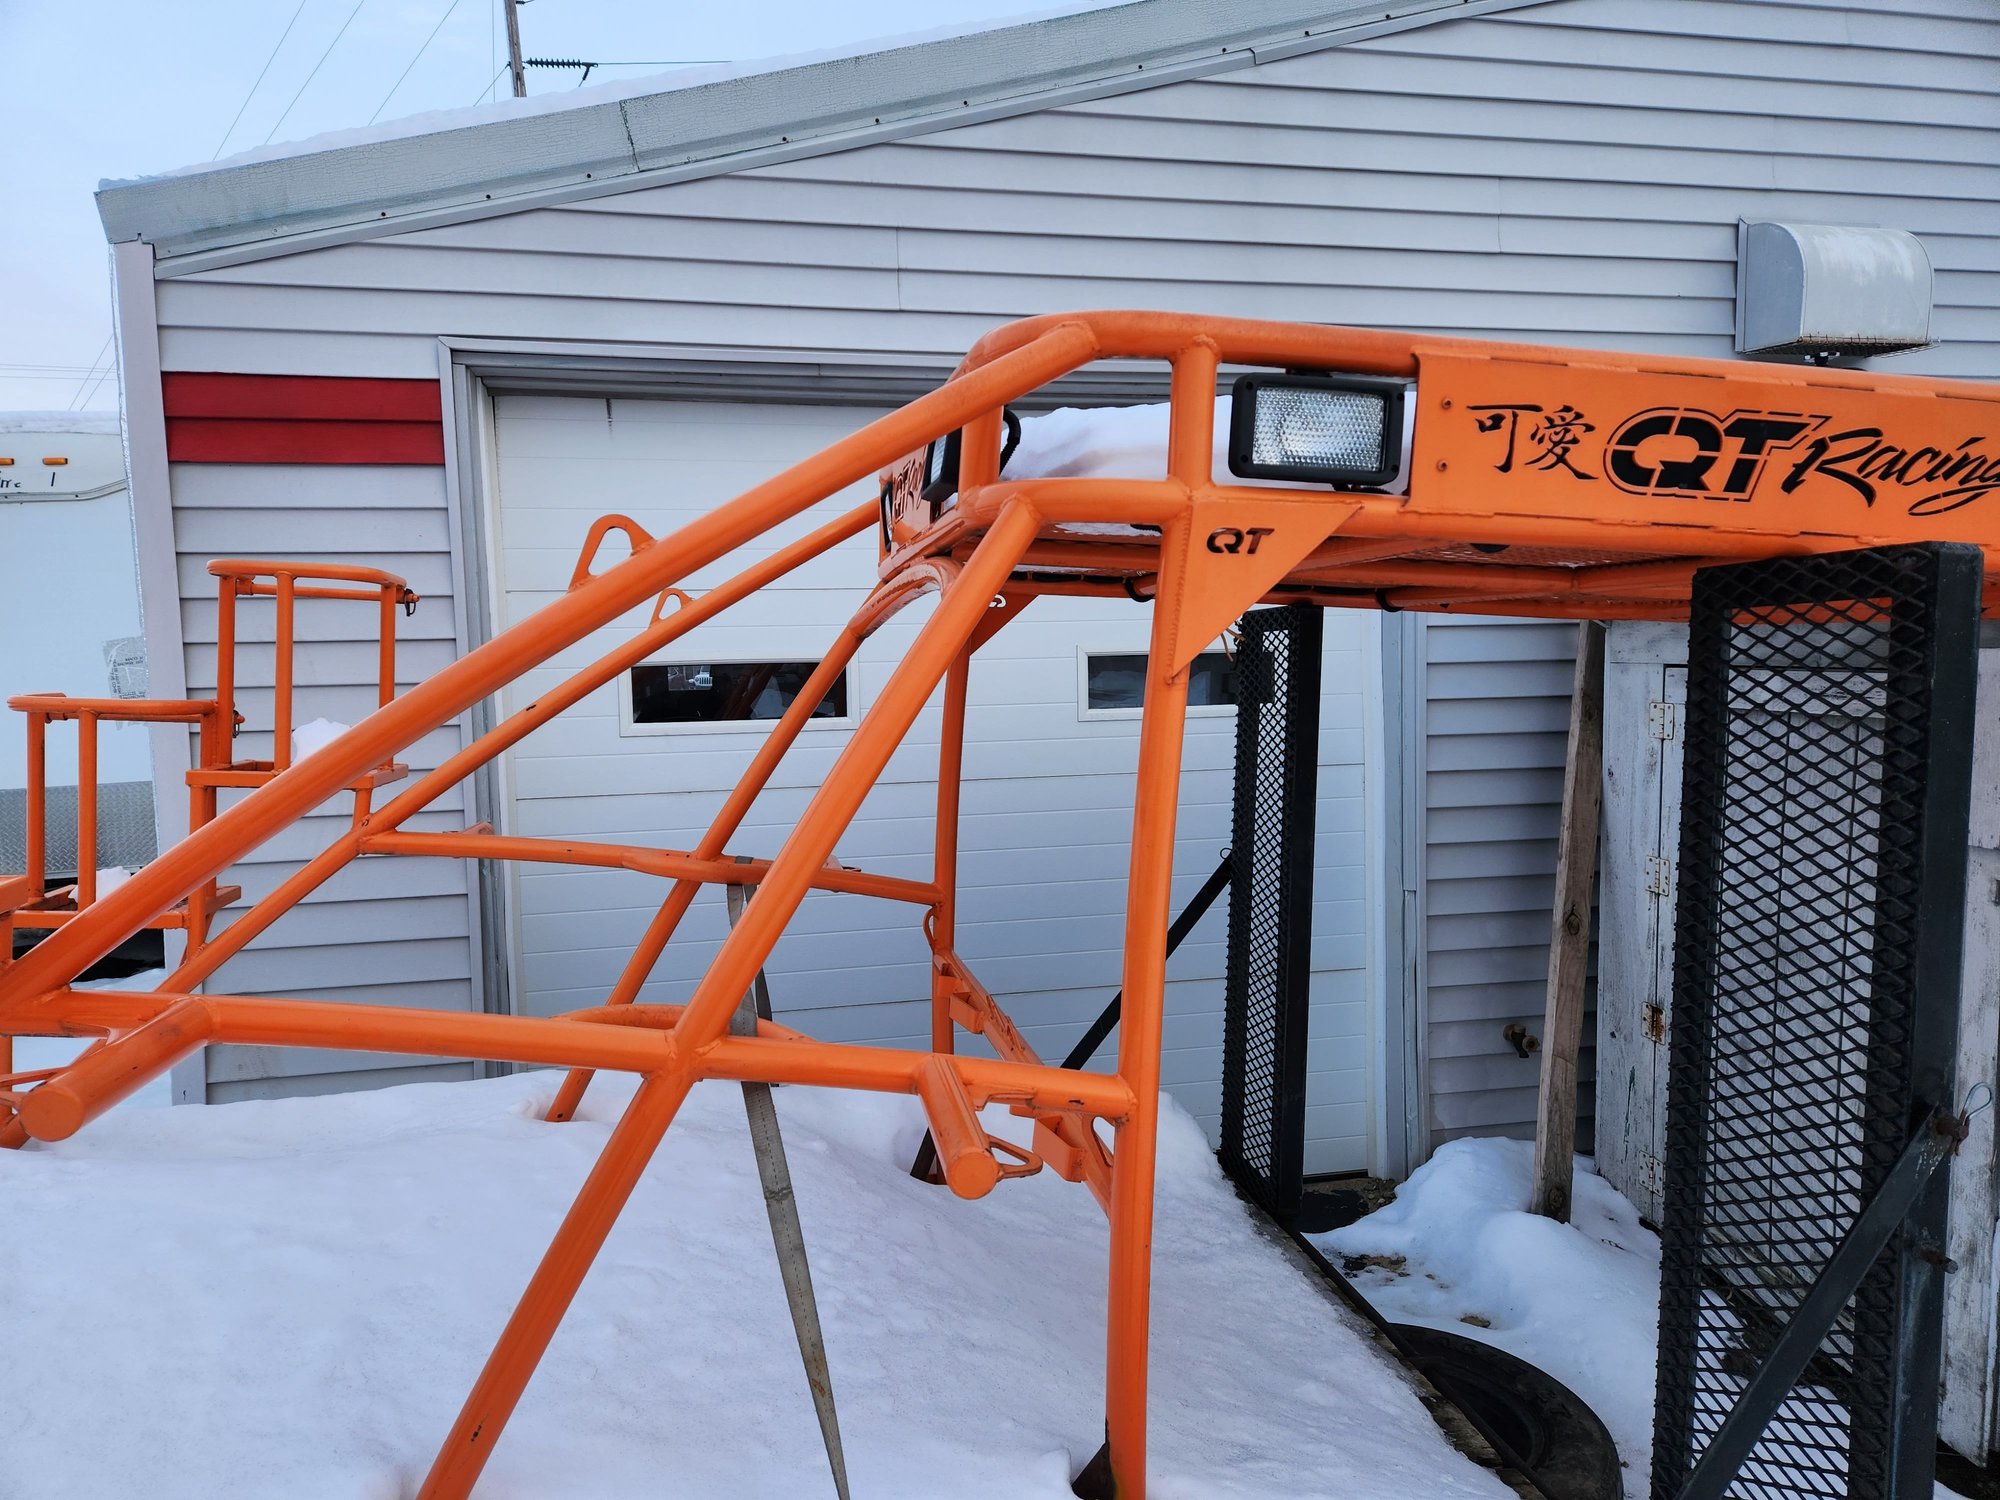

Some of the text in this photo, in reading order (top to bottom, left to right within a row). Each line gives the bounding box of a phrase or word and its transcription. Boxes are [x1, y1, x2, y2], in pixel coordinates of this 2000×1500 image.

[1466, 404, 1599, 480] 可愛
[1603, 406, 1822, 502] QT
[1206, 527, 1275, 555] QT
